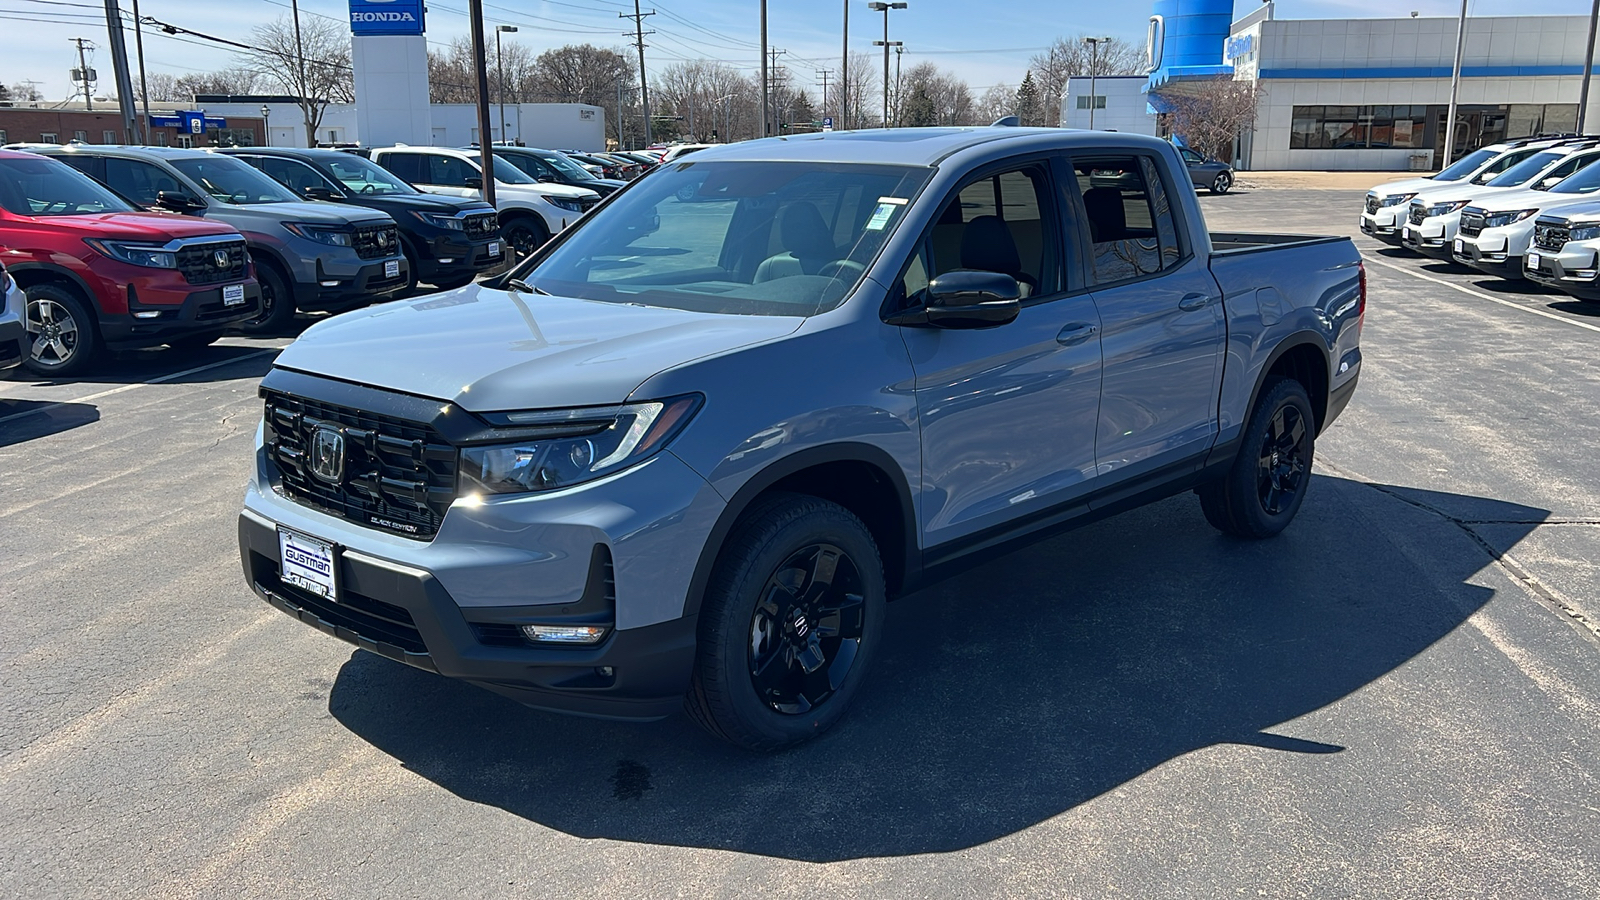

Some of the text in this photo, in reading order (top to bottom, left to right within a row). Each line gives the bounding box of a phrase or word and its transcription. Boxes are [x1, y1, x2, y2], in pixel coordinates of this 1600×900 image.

[351, 12, 416, 22] HONDA
[370, 516, 418, 533] BLACK EDITION
